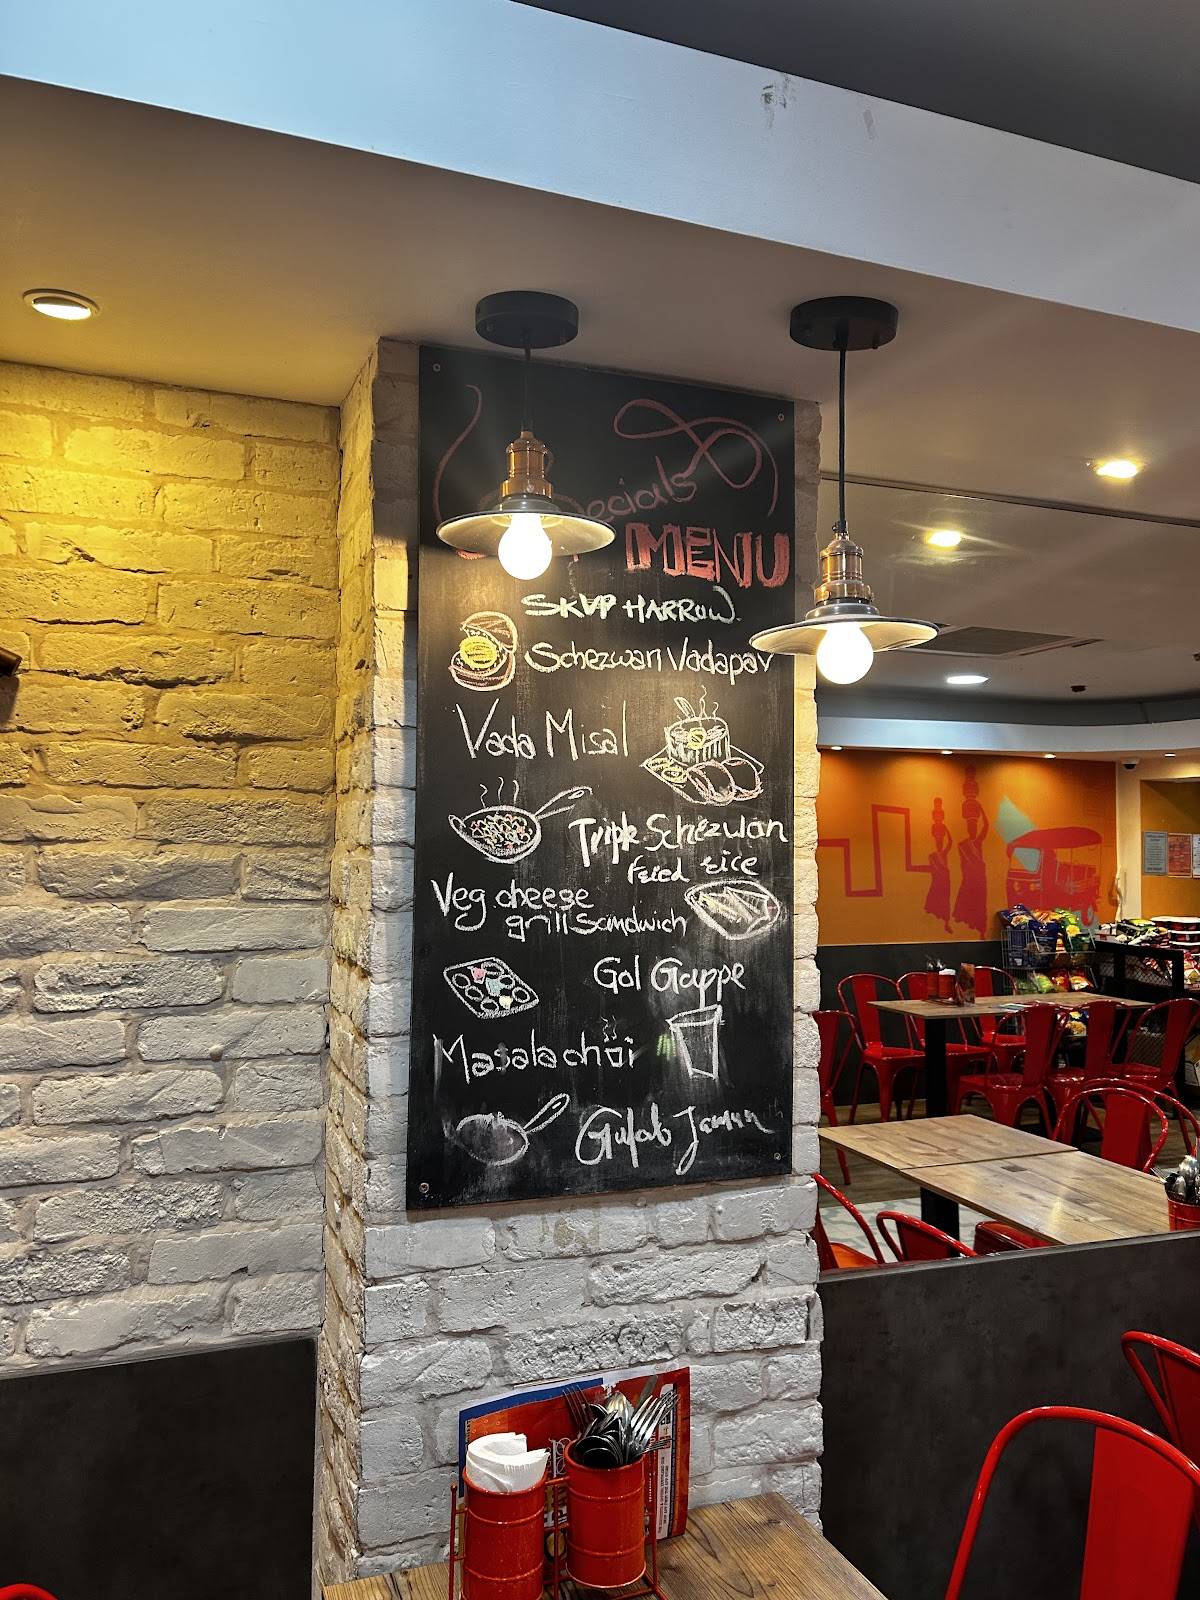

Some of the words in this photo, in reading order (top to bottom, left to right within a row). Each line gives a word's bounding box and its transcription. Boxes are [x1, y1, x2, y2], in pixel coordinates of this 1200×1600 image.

[625, 522, 790, 588] MENU
[524, 641, 662, 673] Schezwan
[667, 637, 774, 685] Vadapav
[456, 698, 536, 760] Vada
[546, 700, 628, 761] Misal
[568, 811, 640, 868] Triple
[495, 879, 594, 910] cheese
[593, 954, 641, 995] Gol
[433, 1028, 557, 1085] Masala
[575, 1102, 672, 1167] Gulab
